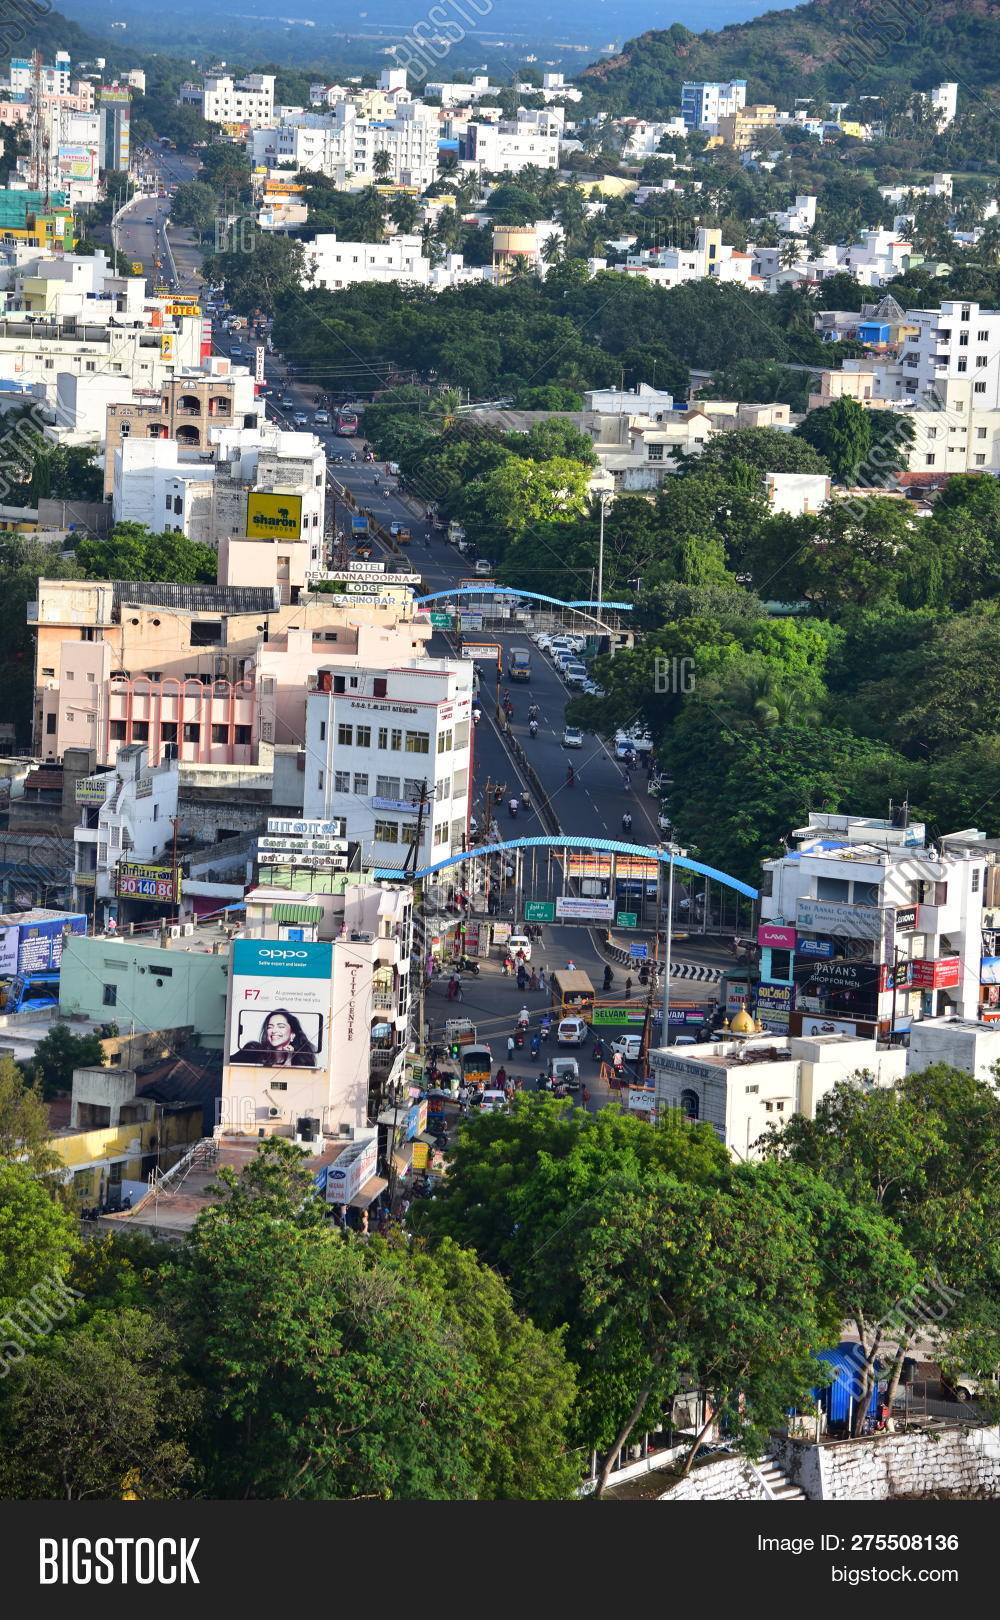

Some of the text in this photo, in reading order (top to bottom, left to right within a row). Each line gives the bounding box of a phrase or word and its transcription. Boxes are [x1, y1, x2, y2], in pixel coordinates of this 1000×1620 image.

[165, 305, 199, 315] HOTEL
[253, 514, 296, 528] sharon
[348, 562, 382, 571] HOTEL
[304, 571, 410, 583] DEVI ANNAPOORNA
[346, 583, 384, 592] LODGE
[76, 780, 106, 792] SET COLLEGE
[120, 879, 136, 892] 90
[137, 881, 156, 894] 140
[800, 941, 830, 951] ASUS
[810, 975, 860, 988] SHOP FOR MEN
[244, 989, 261, 1000] F7
[594, 1010, 627, 1019] SELVAM
[653, 1010, 685, 1020] SEVAM
[347, 1001, 356, 1041] CENTRE
